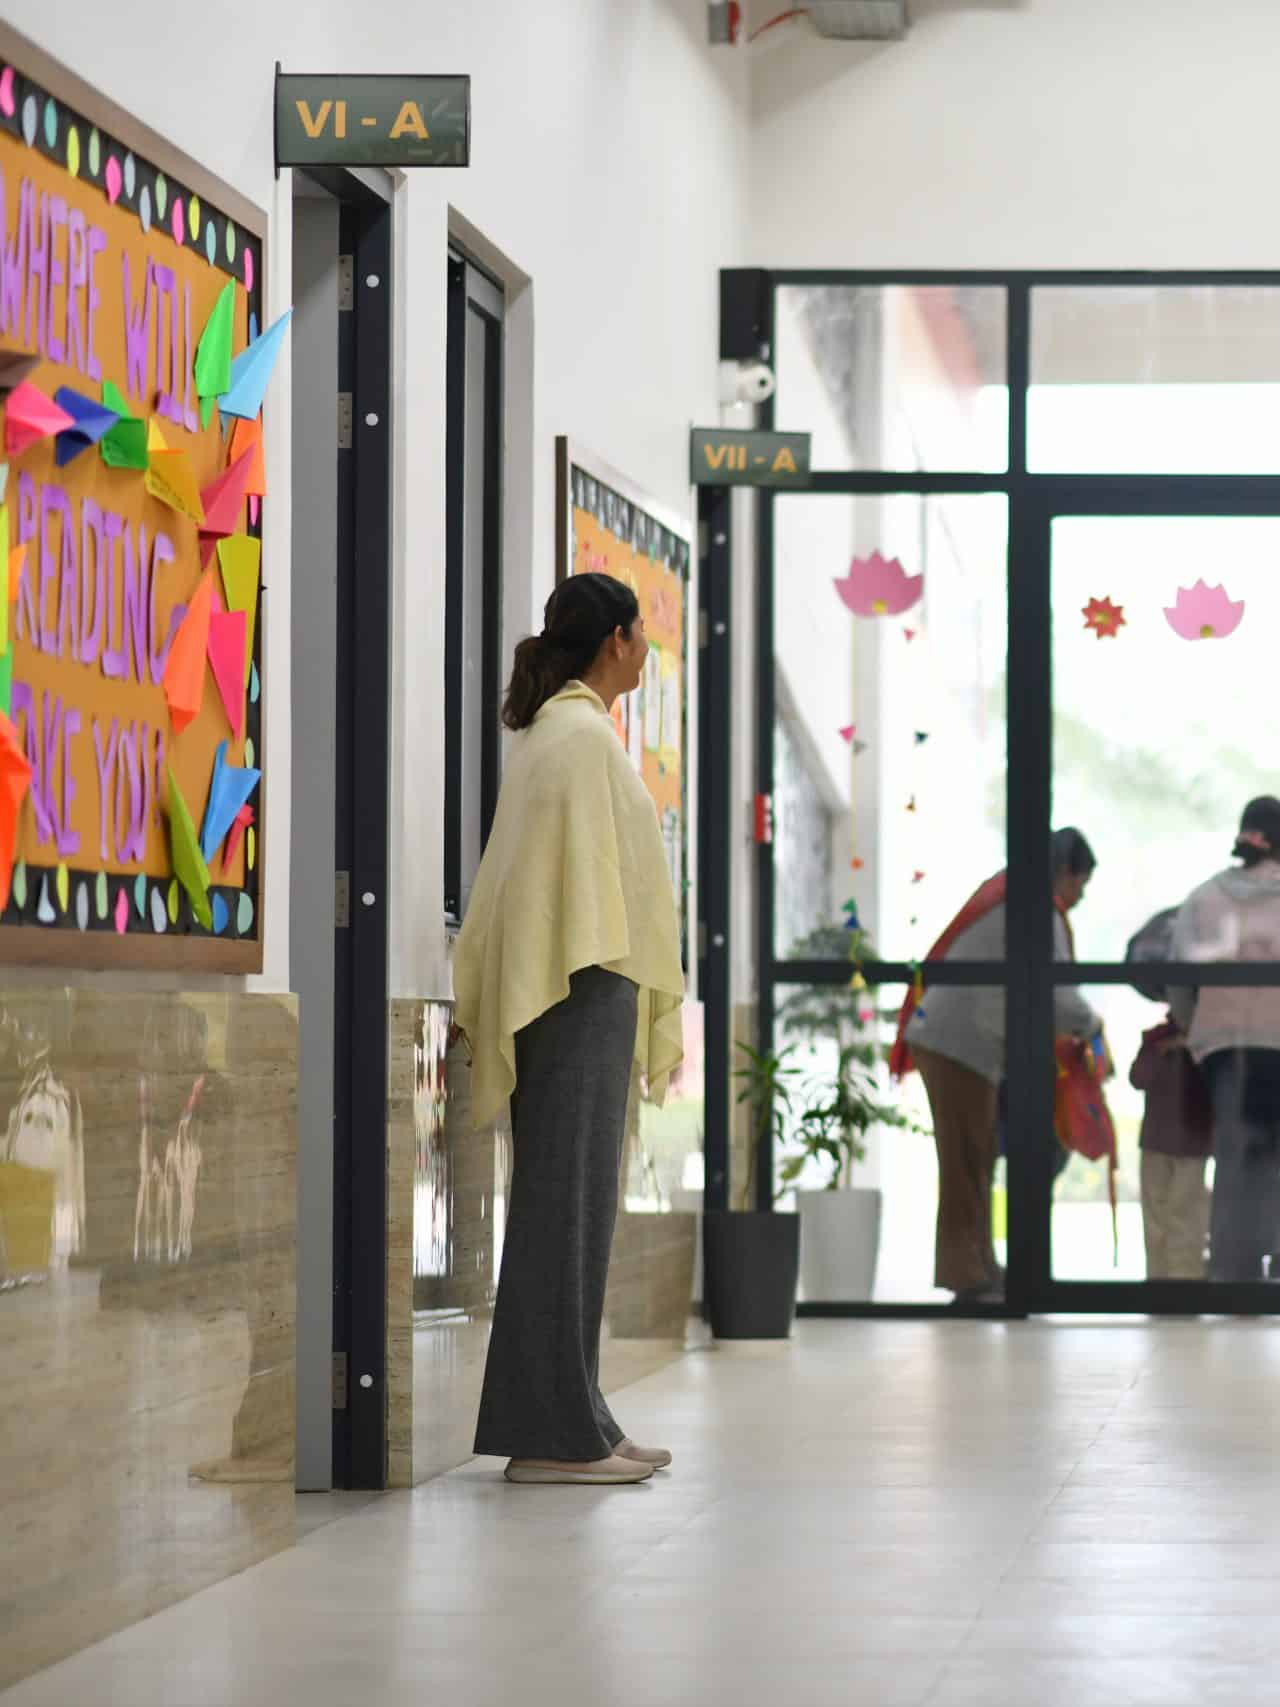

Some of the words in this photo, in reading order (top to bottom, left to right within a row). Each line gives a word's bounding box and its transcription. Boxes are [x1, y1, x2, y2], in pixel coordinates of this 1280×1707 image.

[295, 100, 347, 139] VI
[360, 117, 377, 126] -
[388, 101, 430, 139] A
[0, 163, 107, 383] WHERE
[703, 444, 747, 470] VII
[754, 455, 766, 464] -
[771, 446, 799, 472] A
